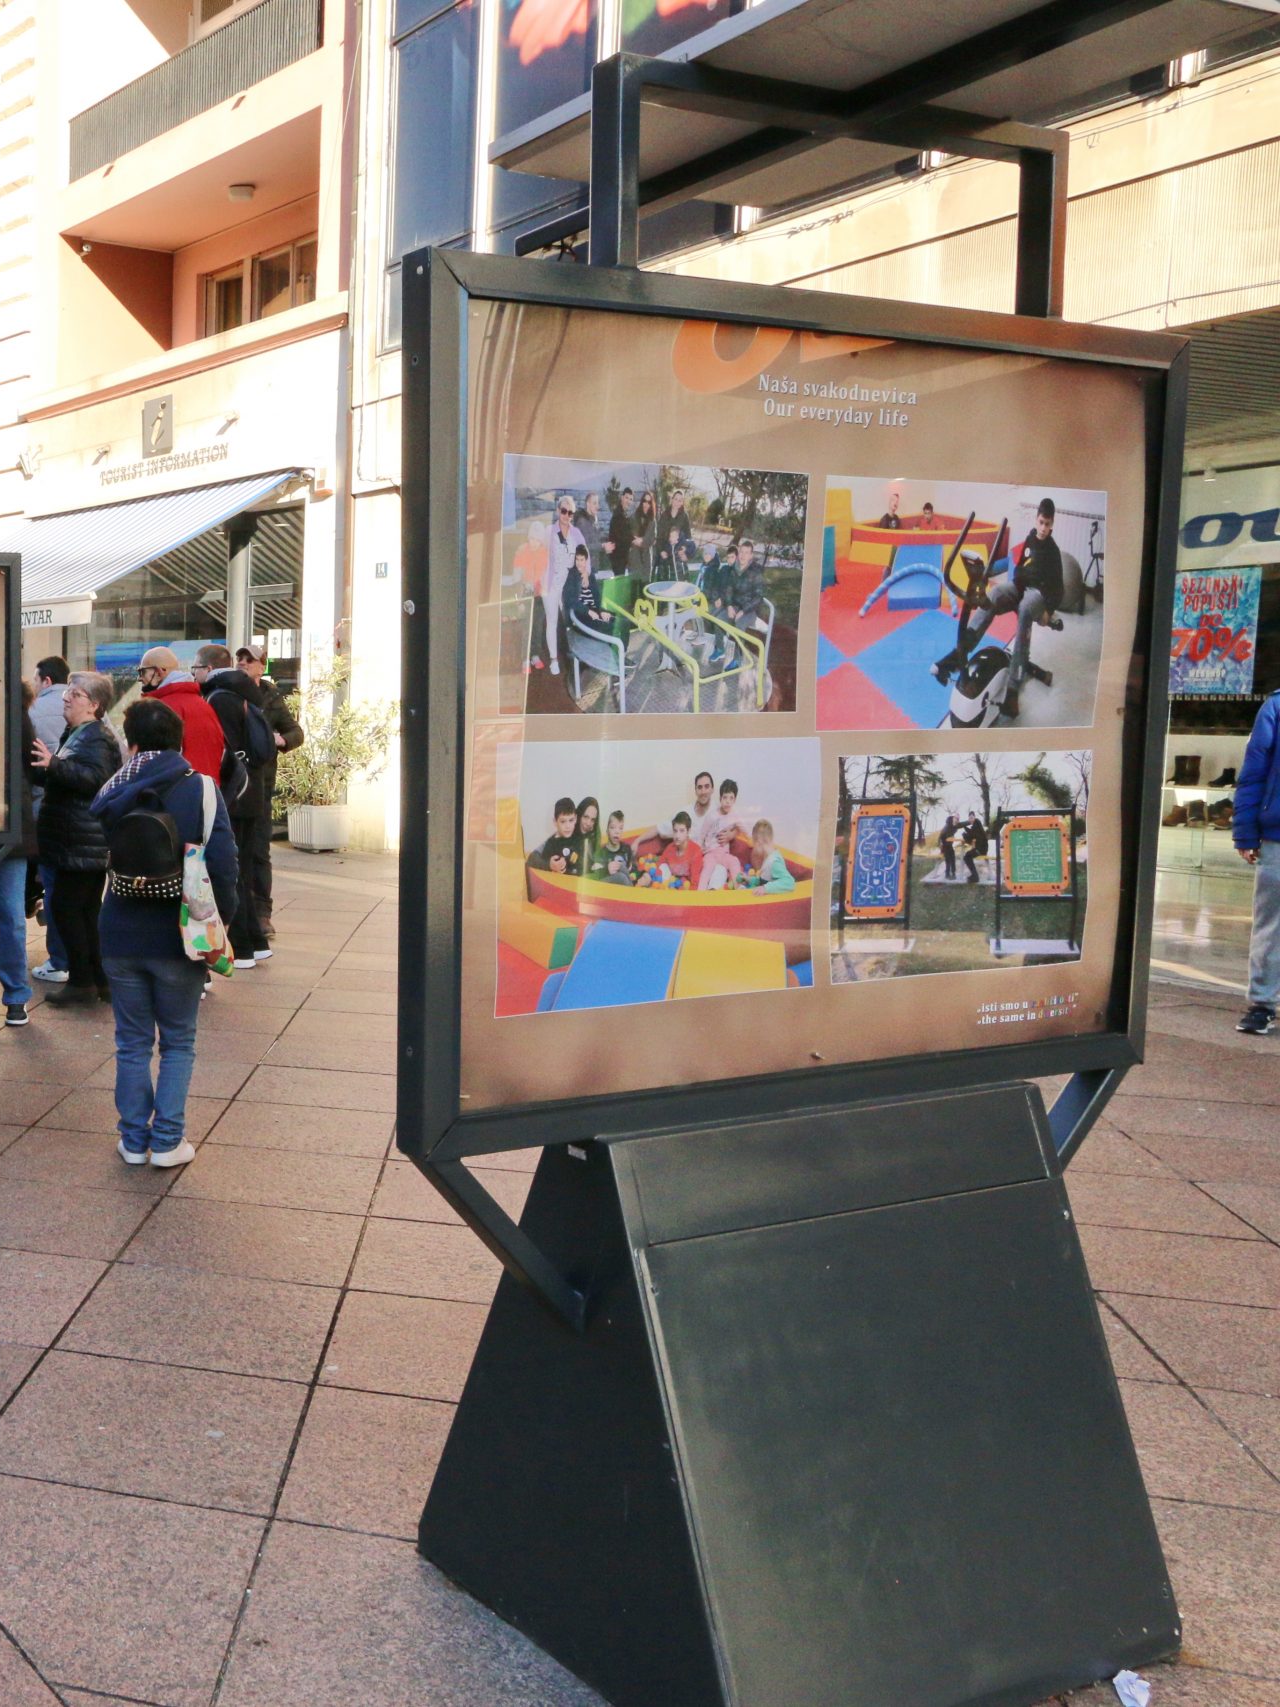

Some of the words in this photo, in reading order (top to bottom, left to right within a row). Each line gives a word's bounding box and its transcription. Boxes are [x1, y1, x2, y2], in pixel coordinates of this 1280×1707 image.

[758, 373, 798, 395] Naša
[803, 380, 917, 405] svakodnevica
[764, 398, 795, 417] Our
[800, 404, 873, 429] everyday
[878, 408, 909, 427] life
[100, 462, 144, 487] TOURIST
[146, 442, 229, 476] INFORMATION
[1182, 575, 1244, 594] SEZONSKI
[1184, 592, 1239, 612] POPUSTI
[1200, 613, 1223, 627] DO
[1170, 627, 1252, 663] 70%
[1000, 1002, 1020, 1011] smo
[1000, 1012, 1024, 1023] same
[1027, 1010, 1036, 1021] in
